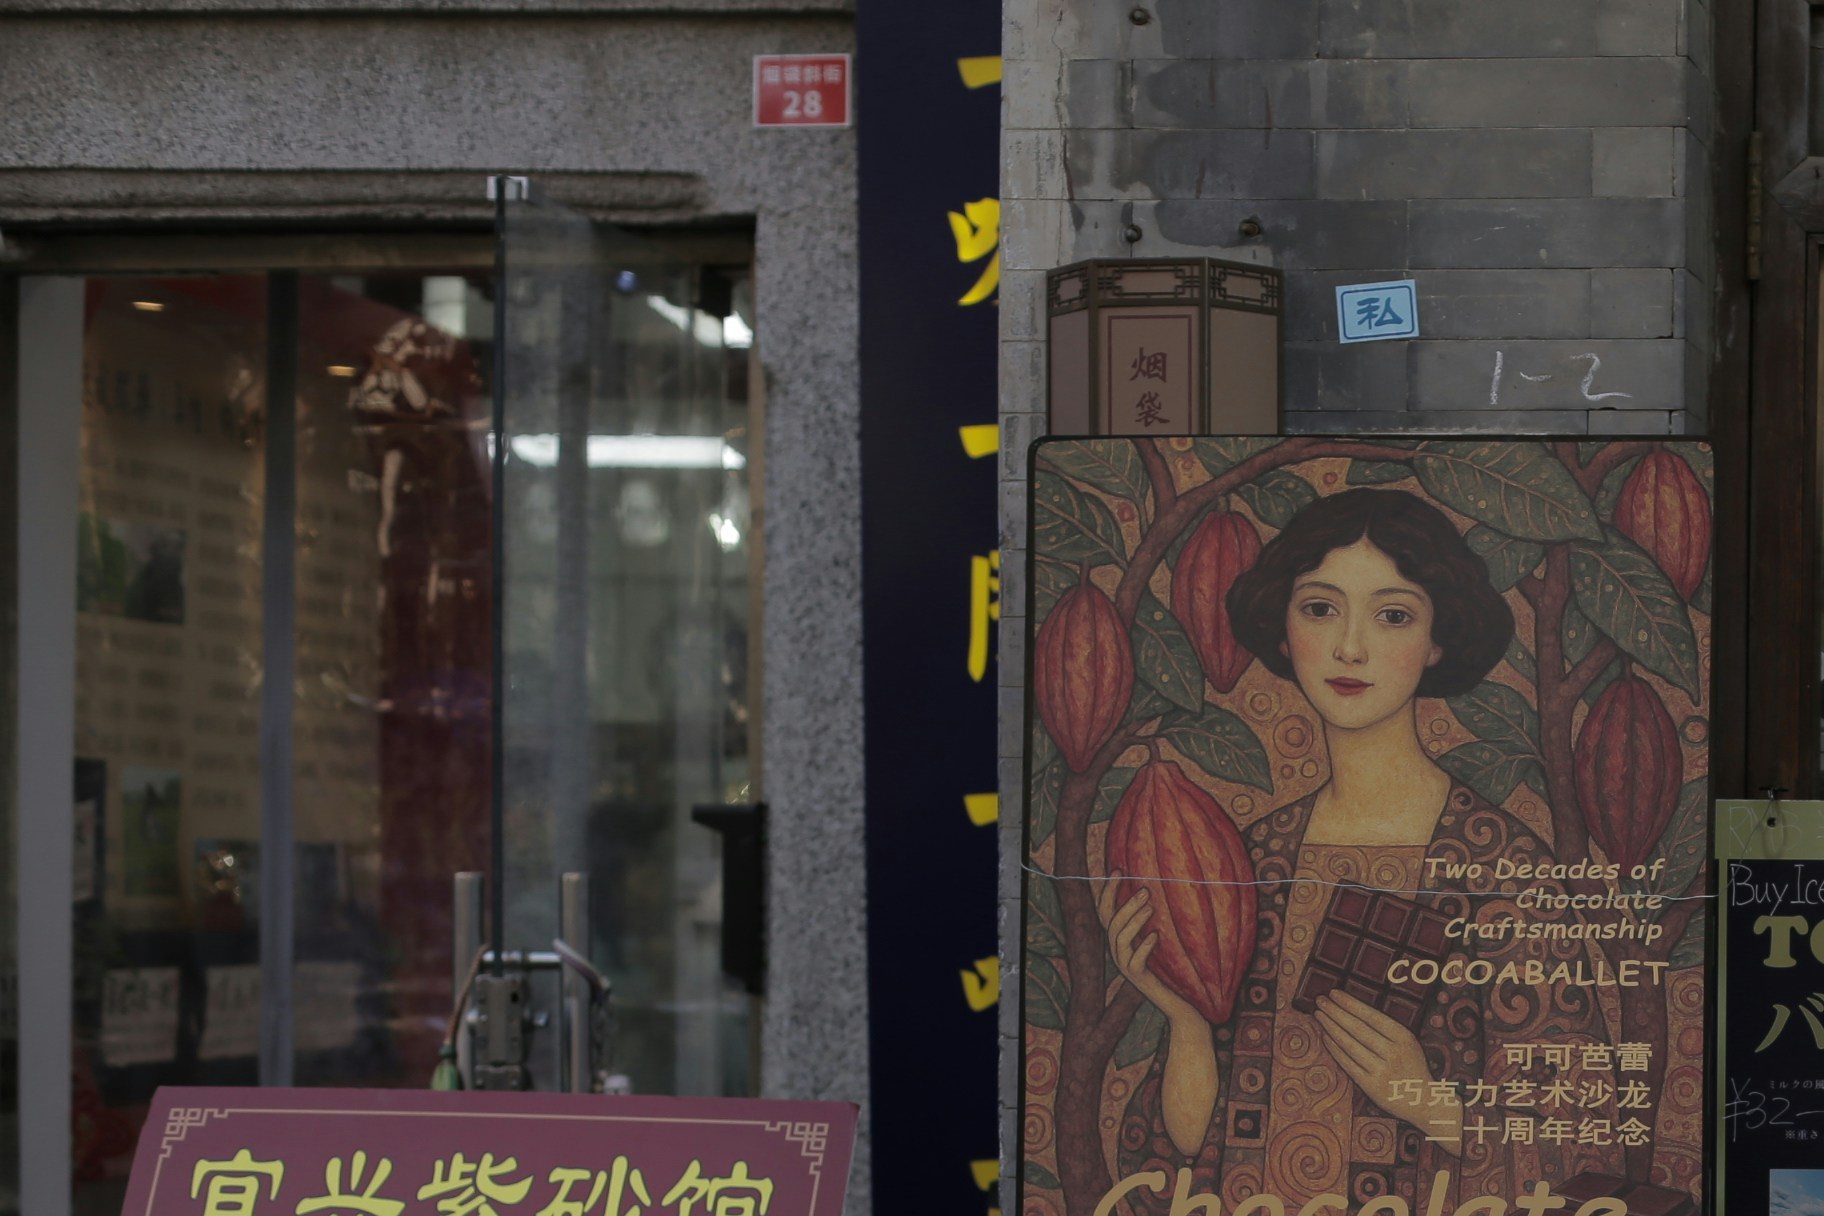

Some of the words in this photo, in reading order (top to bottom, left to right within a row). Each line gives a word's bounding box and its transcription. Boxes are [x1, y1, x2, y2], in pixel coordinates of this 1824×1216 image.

[782, 90, 823, 118] 28
[1424, 856, 1483, 881] Two
[1495, 856, 1619, 882] Decades
[1630, 856, 1665, 881] of
[1514, 886, 1664, 912] Chocolate
[1730, 863, 1790, 916] Buy
[1443, 917, 1664, 946] Craftsmanship
[1387, 958, 1670, 987] COCOABALLET
[1502, 1041, 1654, 1072] 可可芭蕾
[1387, 1077, 1654, 1110] 巧克力艺术沙龙
[1424, 1116, 1653, 1147] 二十周年纪念
